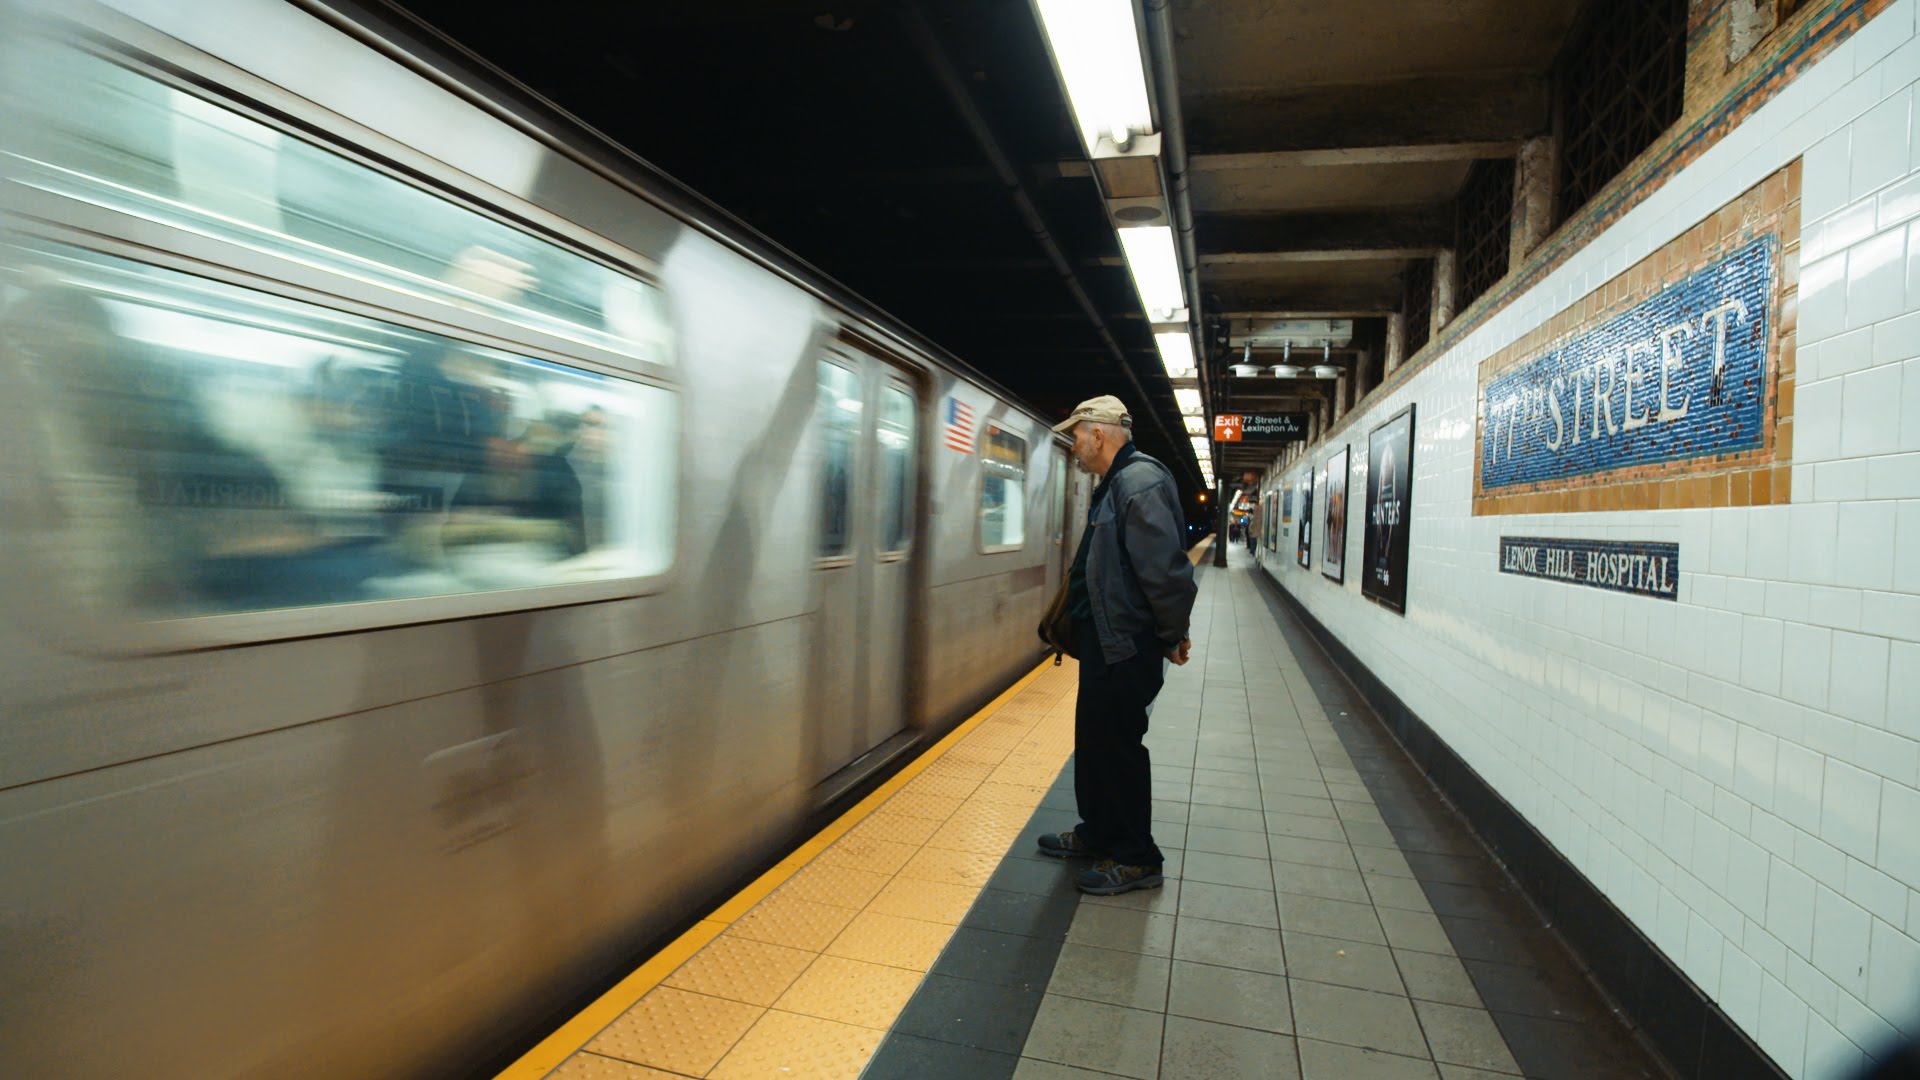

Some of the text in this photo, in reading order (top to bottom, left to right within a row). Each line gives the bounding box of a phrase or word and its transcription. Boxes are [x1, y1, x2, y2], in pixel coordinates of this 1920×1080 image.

[1547, 299, 1749, 452] STREET
[1215, 416, 1239, 426] Exit
[1242, 416, 1290, 424] 77 Street &
[1242, 424, 1285, 433] Lexington
[1505, 546, 1674, 593] LENOX HILL HOSPITAL
